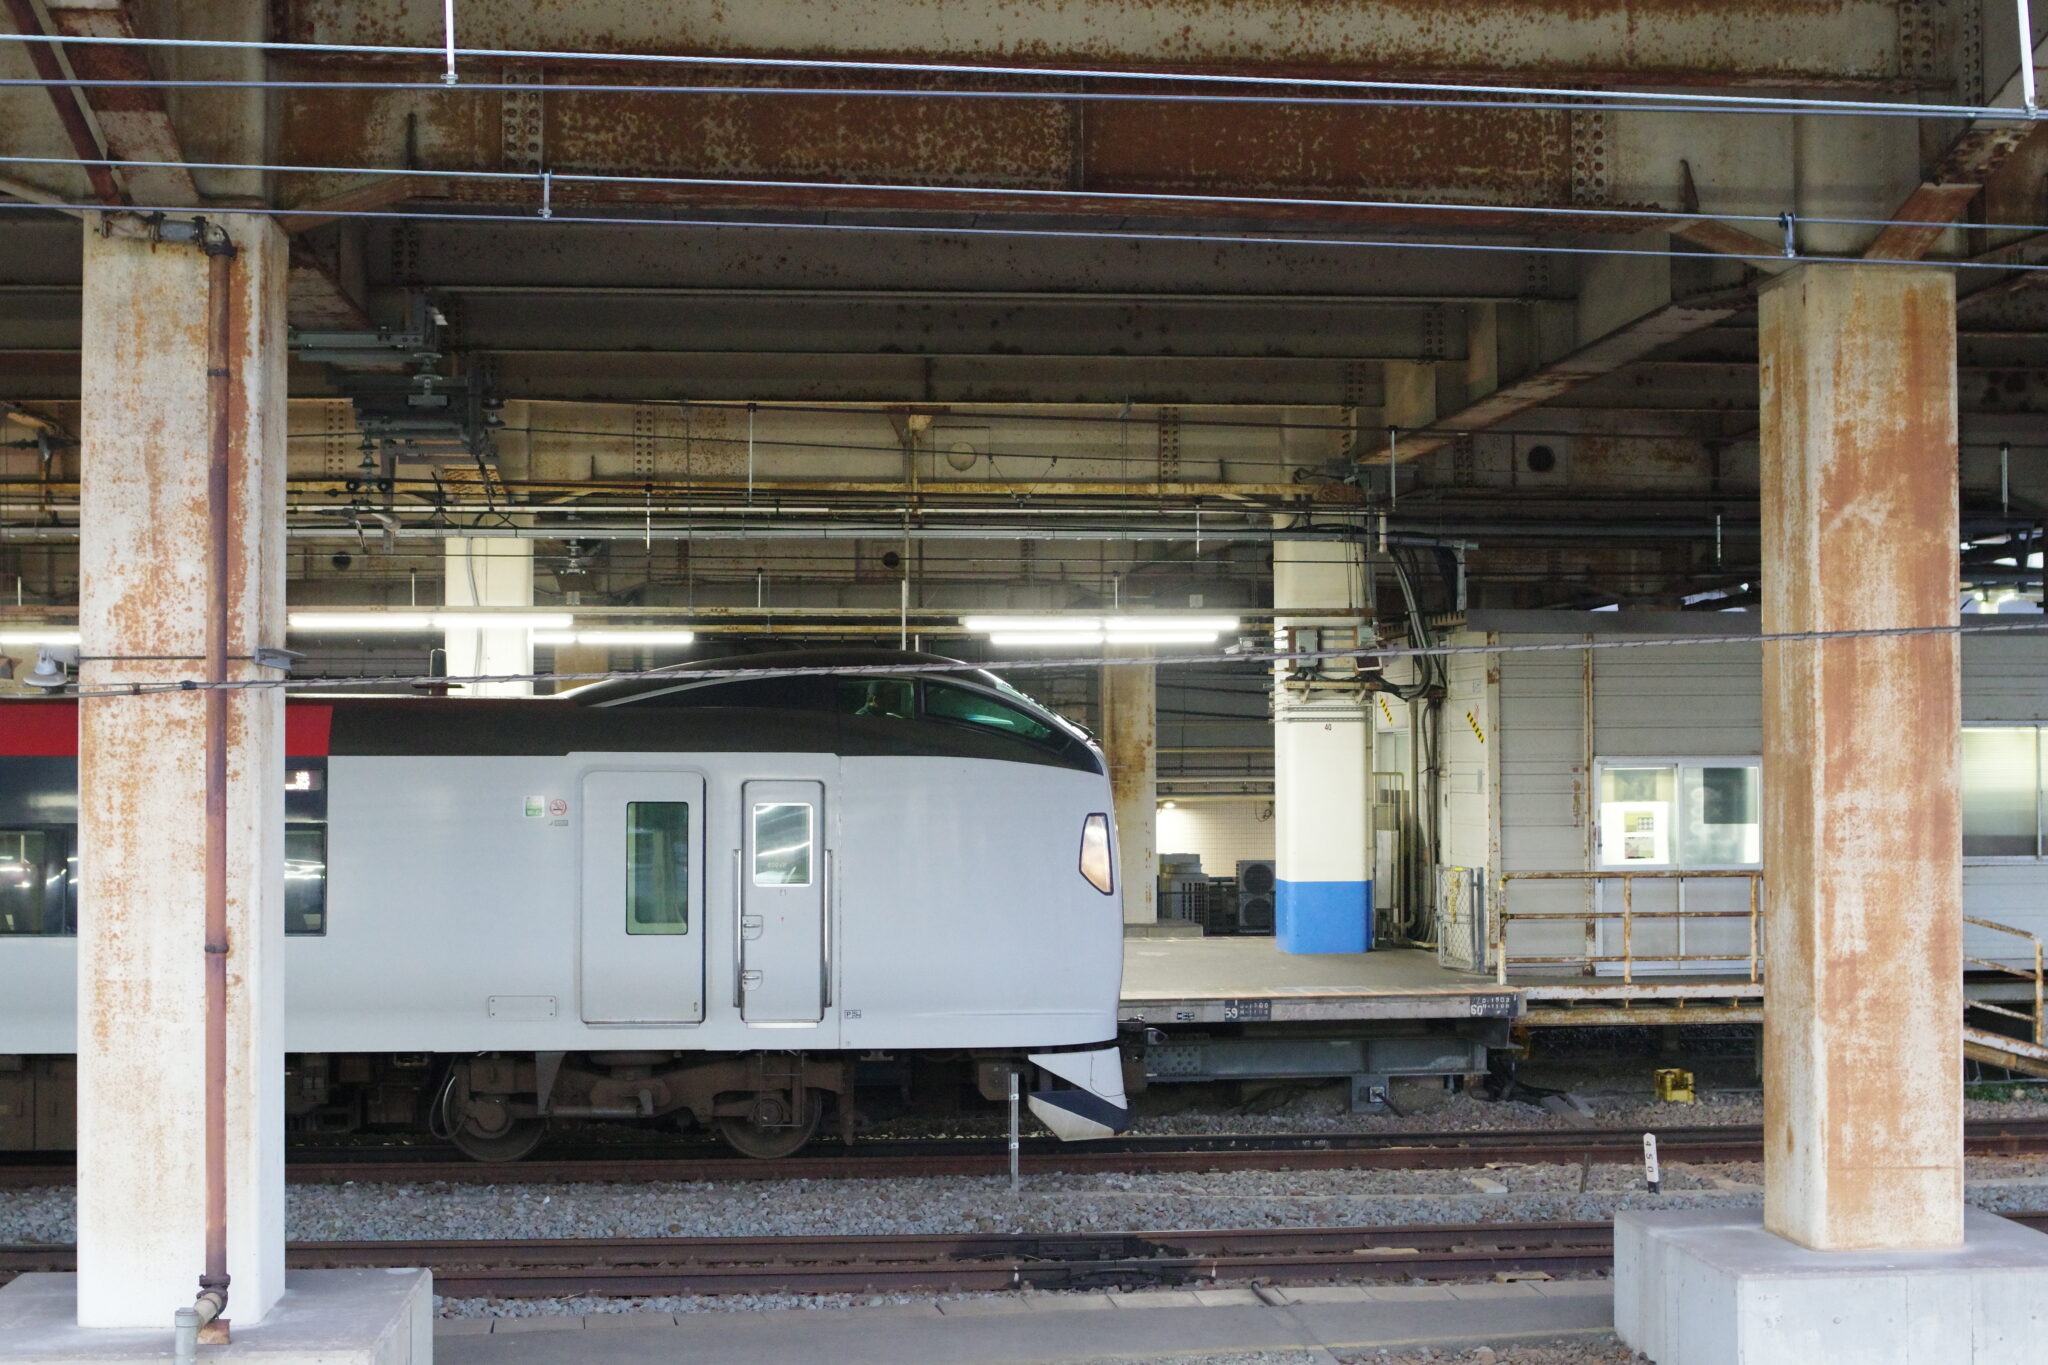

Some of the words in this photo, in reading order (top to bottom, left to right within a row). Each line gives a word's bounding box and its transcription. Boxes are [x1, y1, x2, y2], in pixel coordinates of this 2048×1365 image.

[1324, 723, 1332, 731] 40
[1225, 1007, 1238, 1019] 59
[1470, 1004, 1483, 1016] 60
[1645, 1140, 1655, 1173] 450
